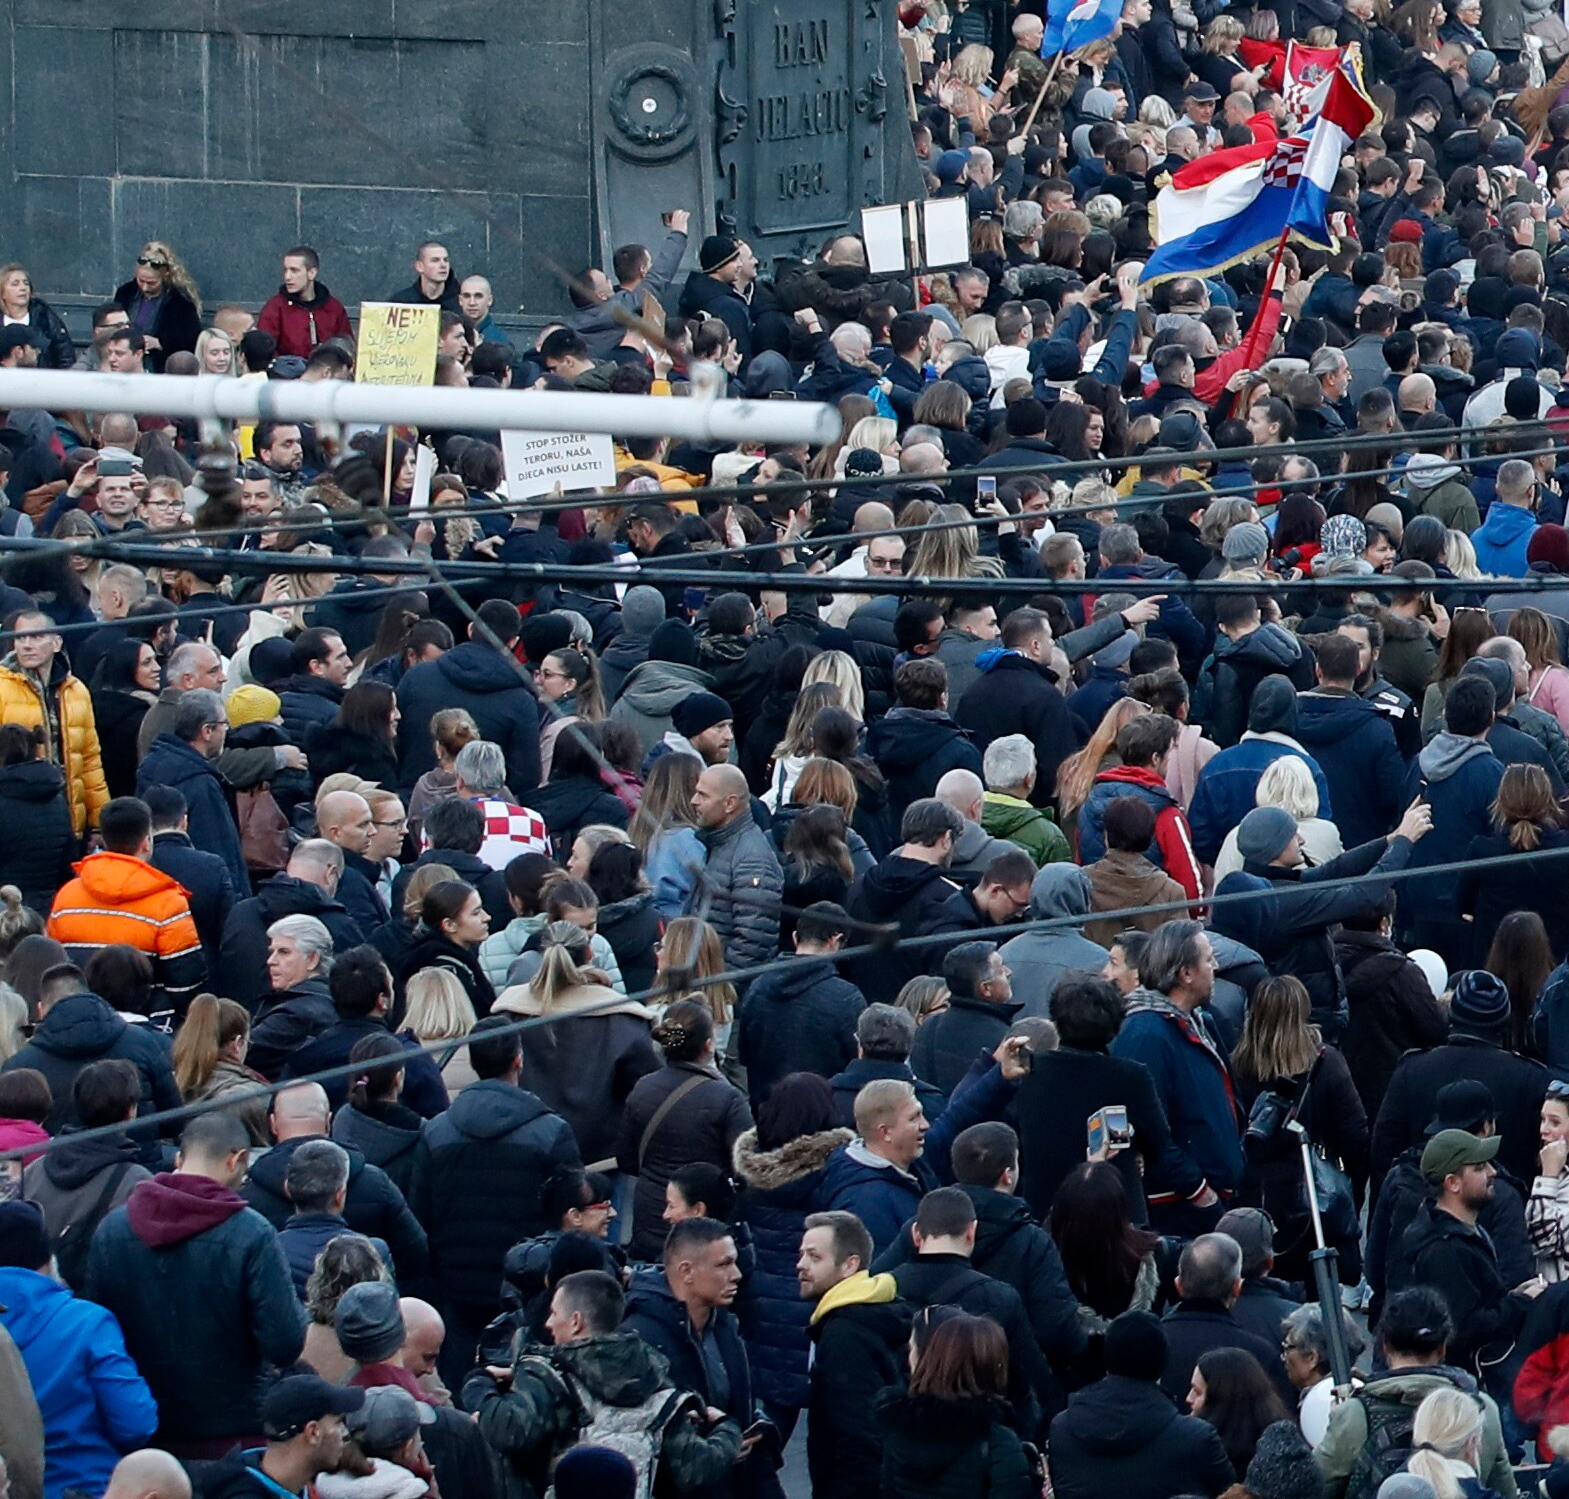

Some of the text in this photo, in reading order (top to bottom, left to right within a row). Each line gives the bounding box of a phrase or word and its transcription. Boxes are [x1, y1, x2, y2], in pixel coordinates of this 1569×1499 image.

[774, 18, 830, 69] BAN
[526, 432, 587, 451] STOP STOŽER
[524, 445, 592, 466] TERORU, NAŠA
[518, 466, 545, 482] DJECA
[547, 462, 570, 475] NISU
